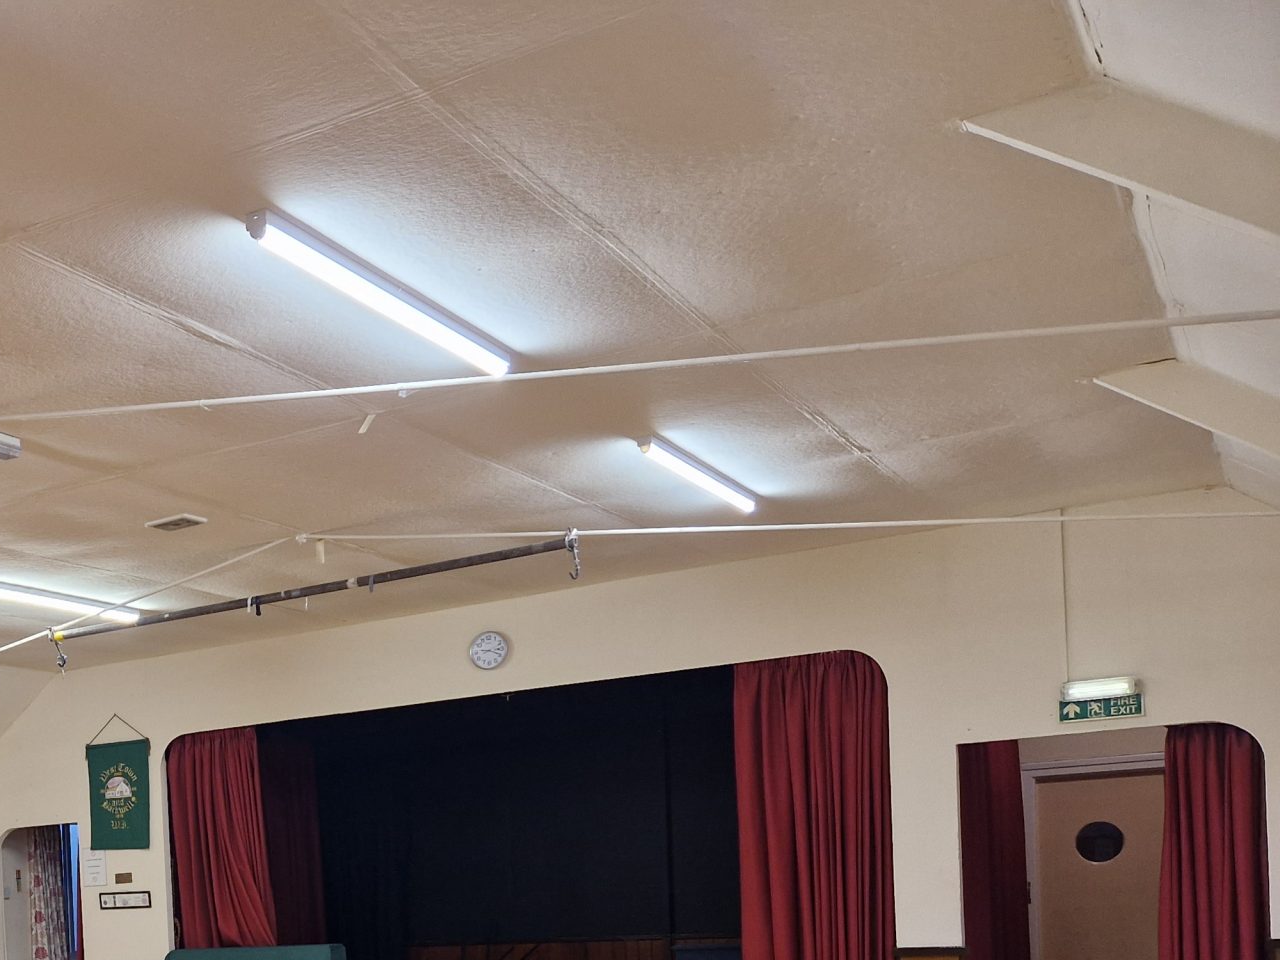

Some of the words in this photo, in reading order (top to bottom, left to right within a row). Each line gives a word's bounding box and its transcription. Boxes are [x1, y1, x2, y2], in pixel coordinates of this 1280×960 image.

[1110, 695, 1137, 706] FIRE
[1110, 705, 1137, 715] EXIT
[118, 763, 137, 781] Town
